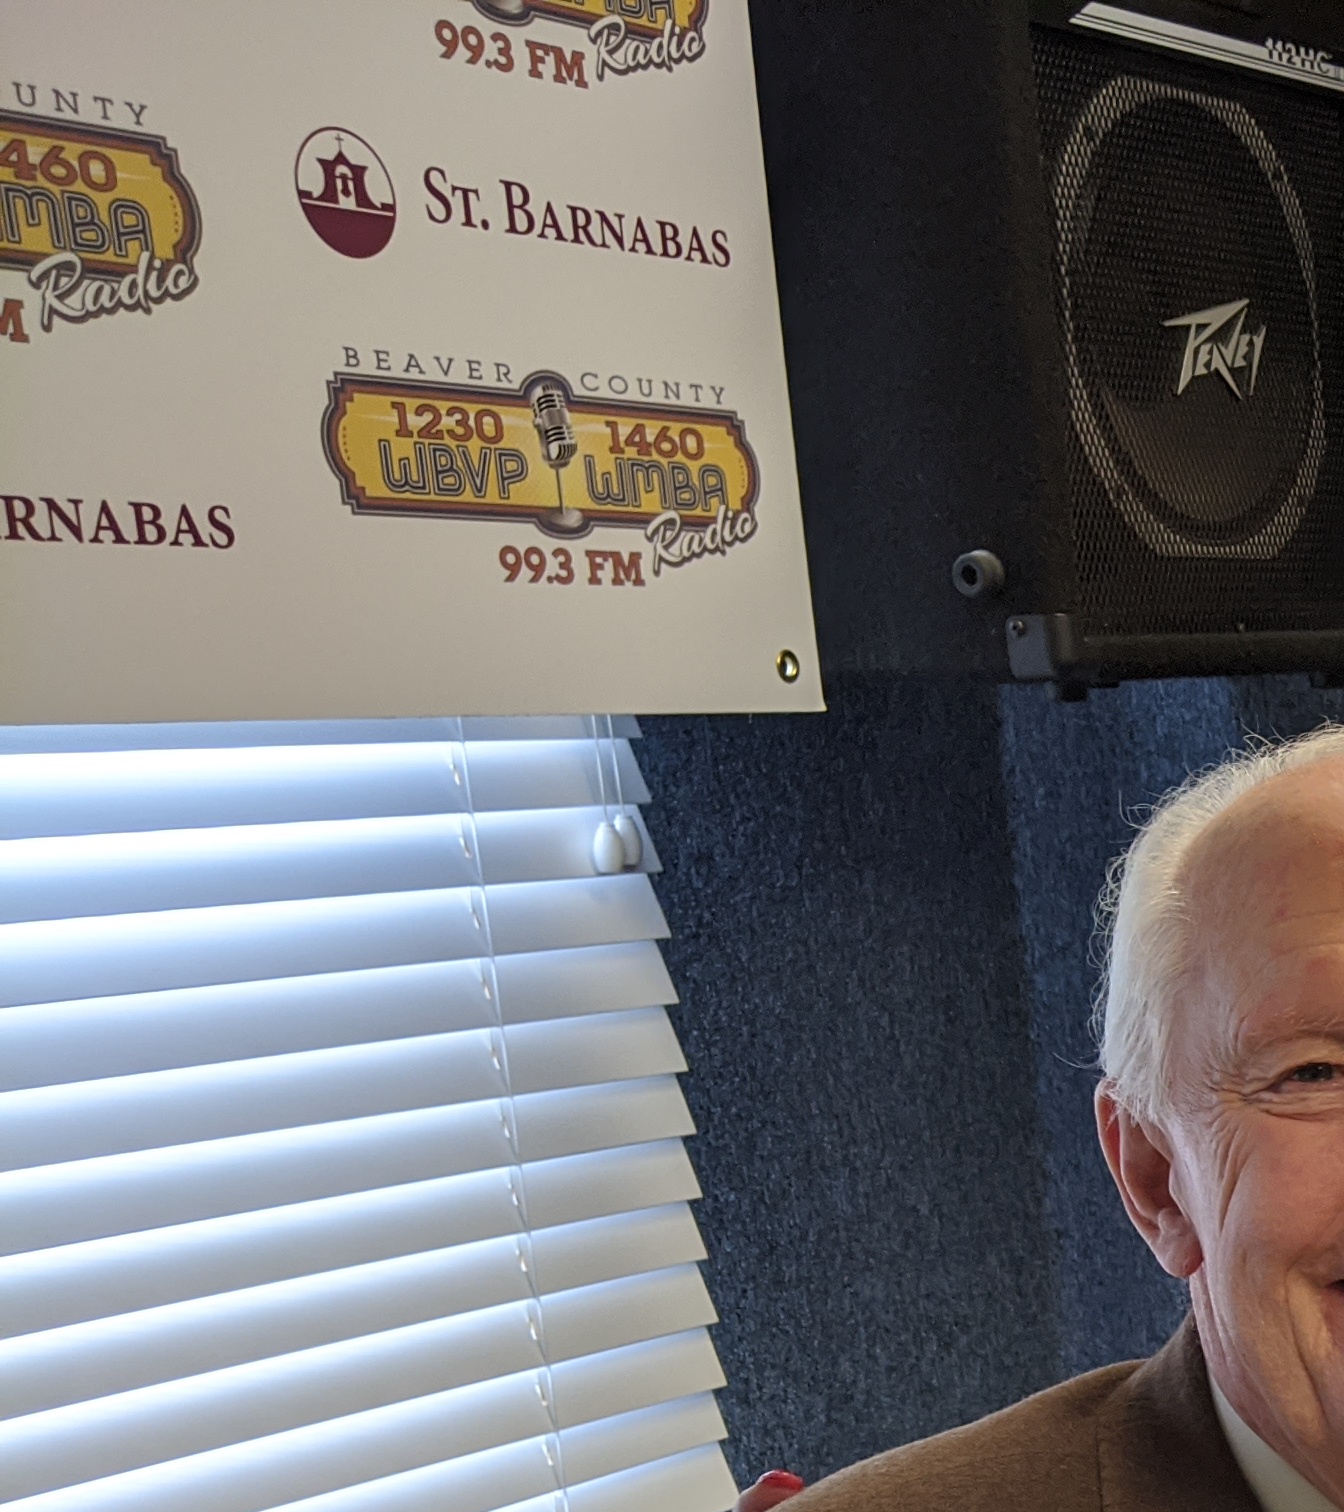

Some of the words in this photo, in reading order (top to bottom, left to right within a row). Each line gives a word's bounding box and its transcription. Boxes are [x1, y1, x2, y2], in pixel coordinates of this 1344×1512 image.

[434, 19, 515, 73] 99.3
[524, 39, 589, 89] FM
[588, 13, 706, 82] Radio
[0, 181, 154, 258] MBA
[28, 250, 199, 332] Radio
[343, 346, 513, 384] BEAVER
[580, 371, 726, 405] COUNTY
[391, 402, 504, 446] 1230
[605, 420, 705, 462] 1460
[378, 438, 529, 500] WBVP
[585, 453, 728, 512] WMBA
[0, 495, 235, 549] RNABAS
[646, 504, 758, 576] Radio
[499, 546, 575, 586] 99.3
[585, 549, 646, 587] FM
